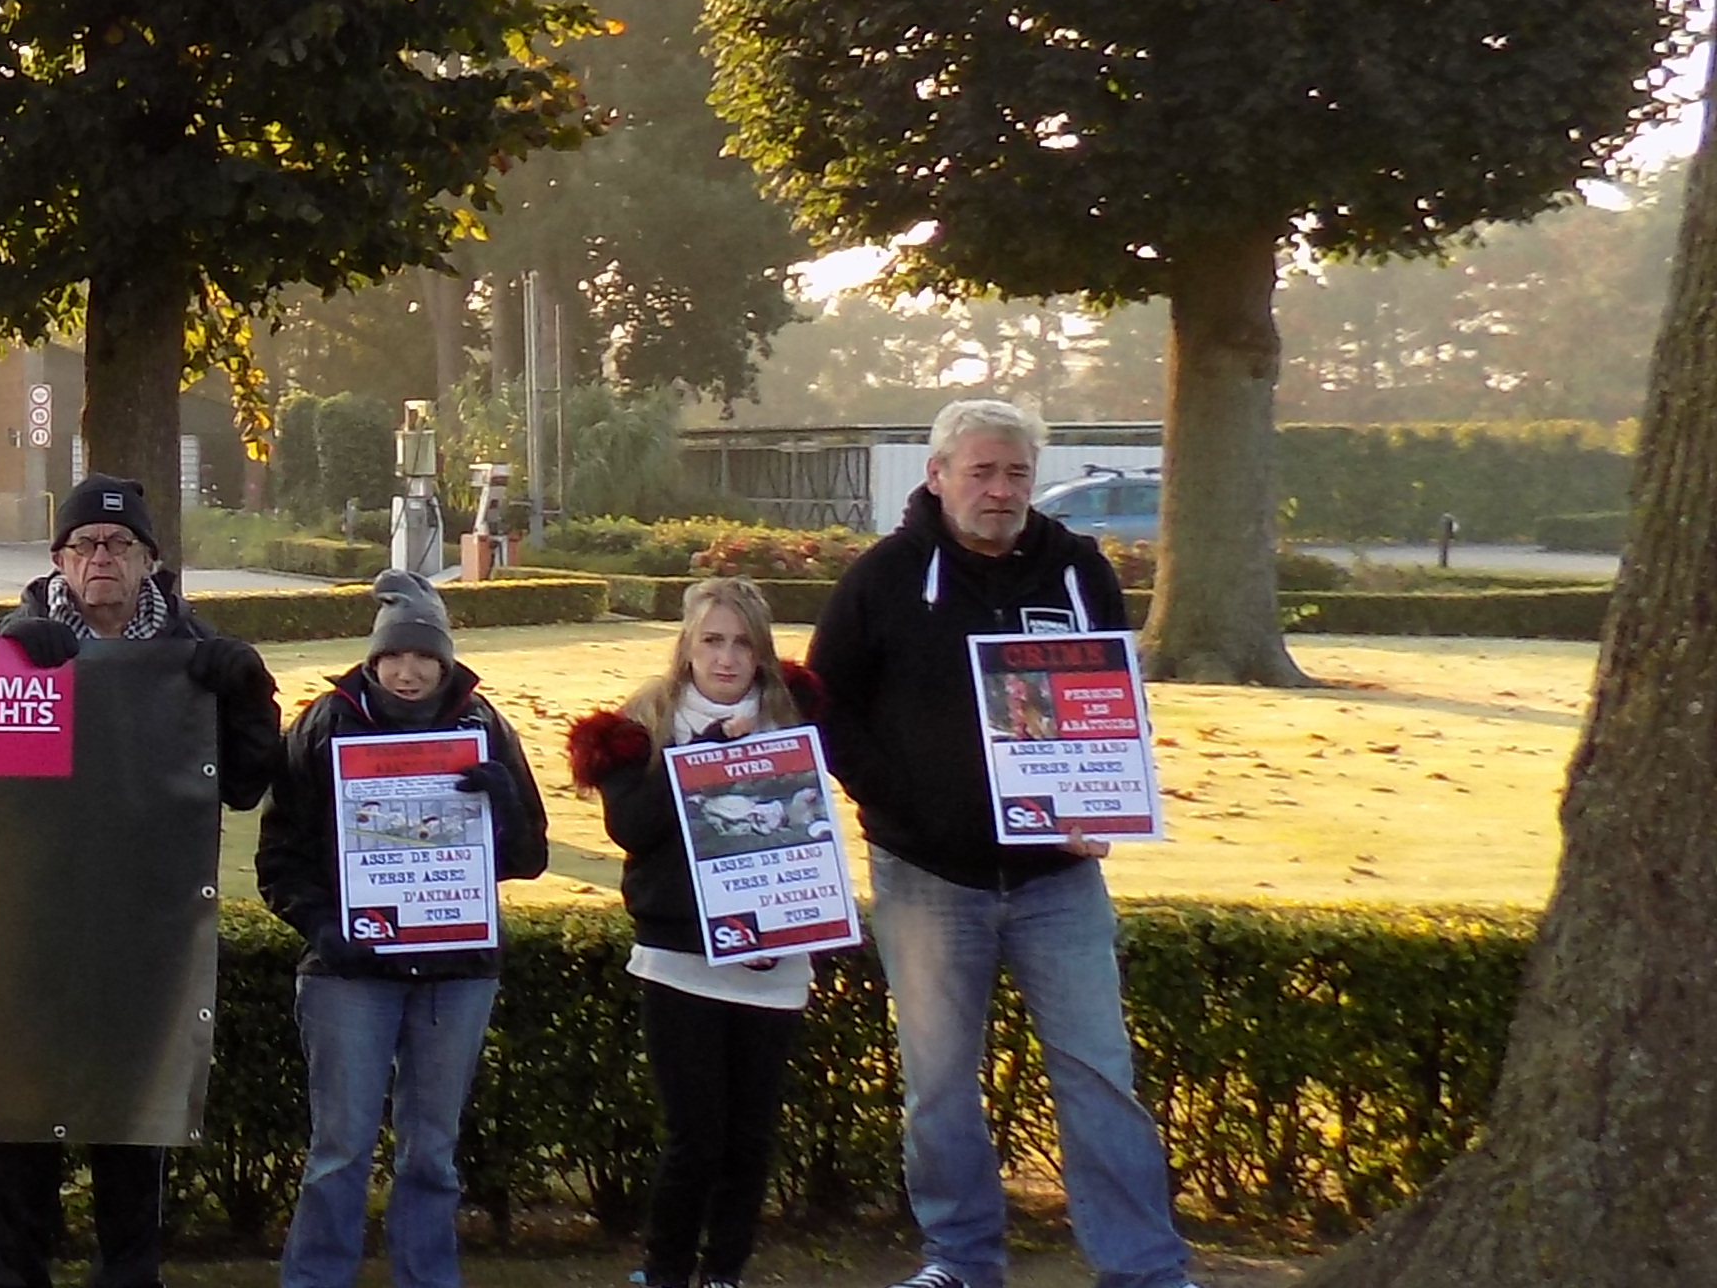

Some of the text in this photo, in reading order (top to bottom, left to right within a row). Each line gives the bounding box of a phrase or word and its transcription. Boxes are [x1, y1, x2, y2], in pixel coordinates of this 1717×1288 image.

[35, 412, 46, 421] 15
[1003, 642, 1106, 667] CRIME
[684, 749, 724, 768] VIVRE
[727, 746, 743, 759] ET
[1008, 741, 1128, 756] ASSEZ DE SANG
[1018, 761, 1124, 775] VERSE ASSEZ
[1058, 780, 1142, 793] D'ANIMAUX
[1083, 800, 1122, 812] TUES
[1007, 807, 1054, 829] SEA
[360, 848, 472, 866] ASSEZ DE SANG
[710, 846, 823, 875] ASSEZ DE SANG
[368, 868, 466, 886] VERSE ASSEZ
[722, 867, 819, 893] VERSE ASSEZ
[403, 887, 481, 903] D'ANIMAUX
[759, 884, 839, 907] D'ANIMAUX
[424, 907, 461, 920] TUES
[784, 907, 820, 923] TUES
[353, 918, 396, 939] SEA
[715, 926, 758, 950] SEA
